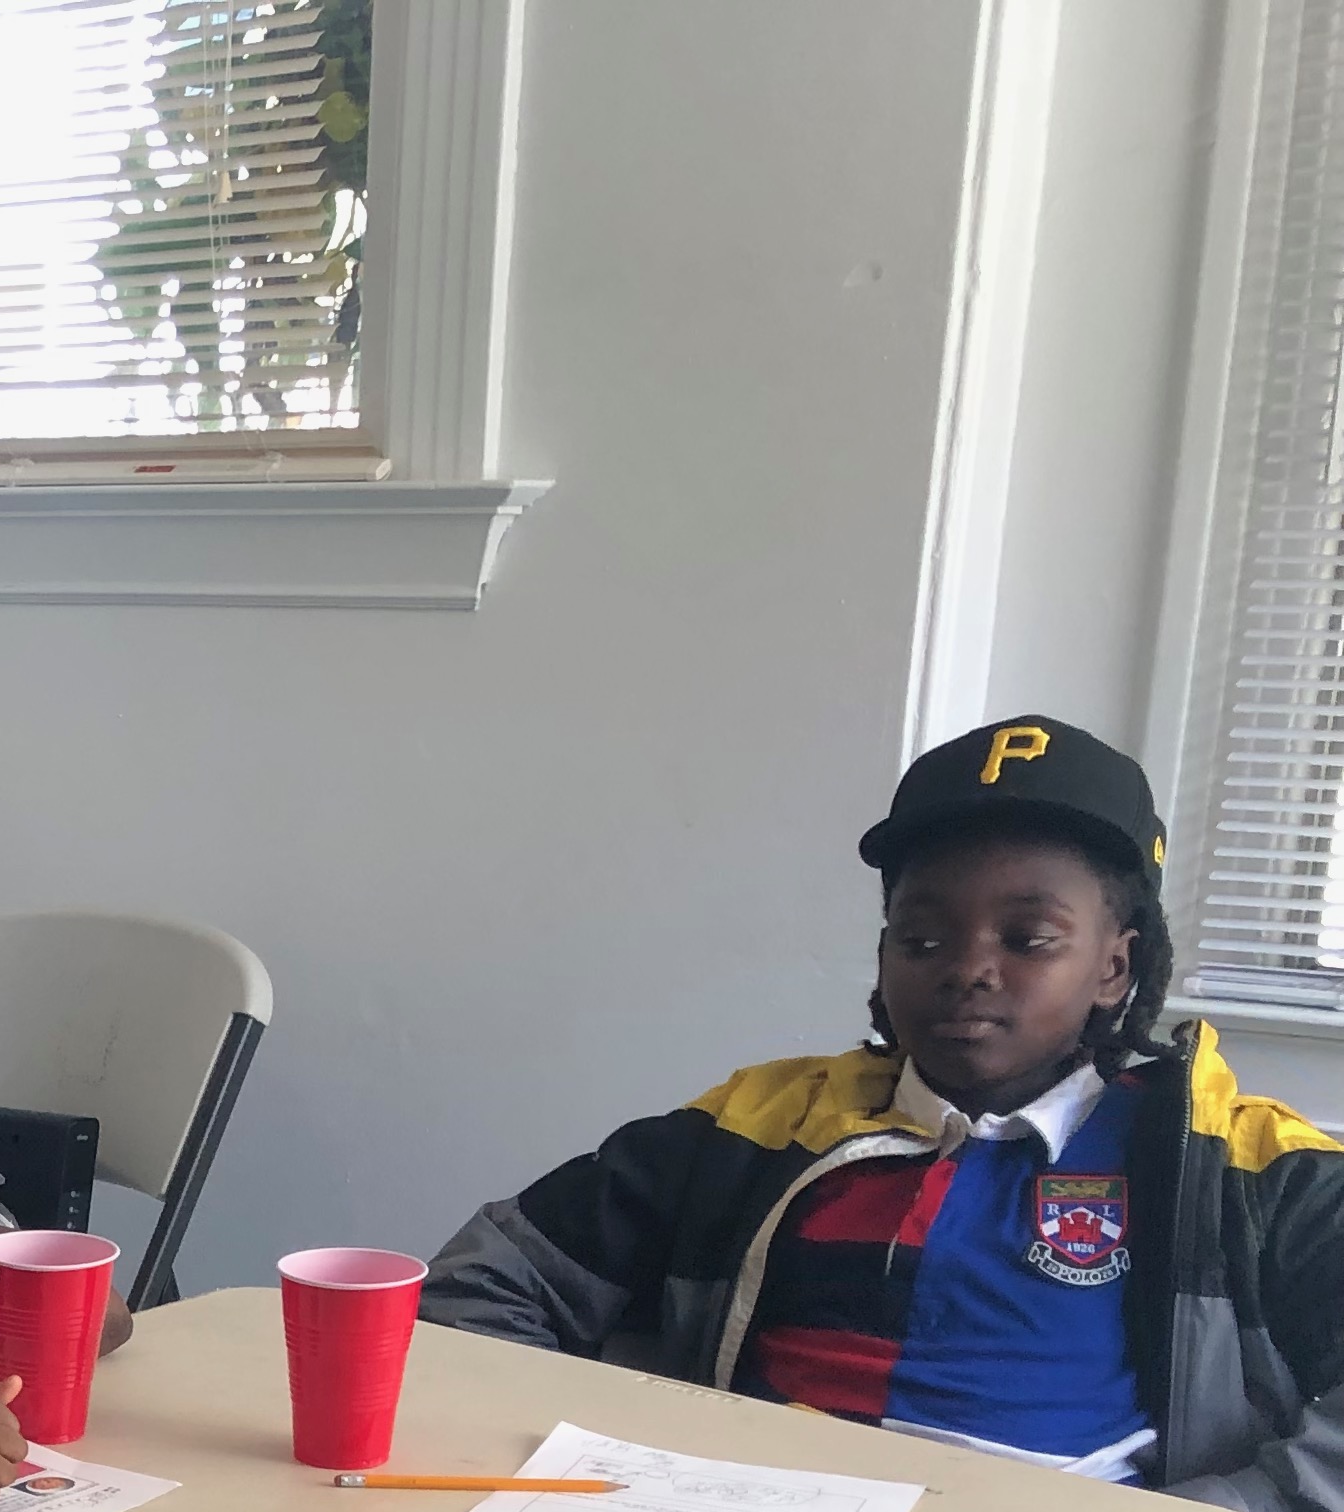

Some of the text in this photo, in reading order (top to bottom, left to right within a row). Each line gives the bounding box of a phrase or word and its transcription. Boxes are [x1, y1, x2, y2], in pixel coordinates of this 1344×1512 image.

[980, 727, 1050, 784] P
[1047, 1203, 1115, 1218] R L
